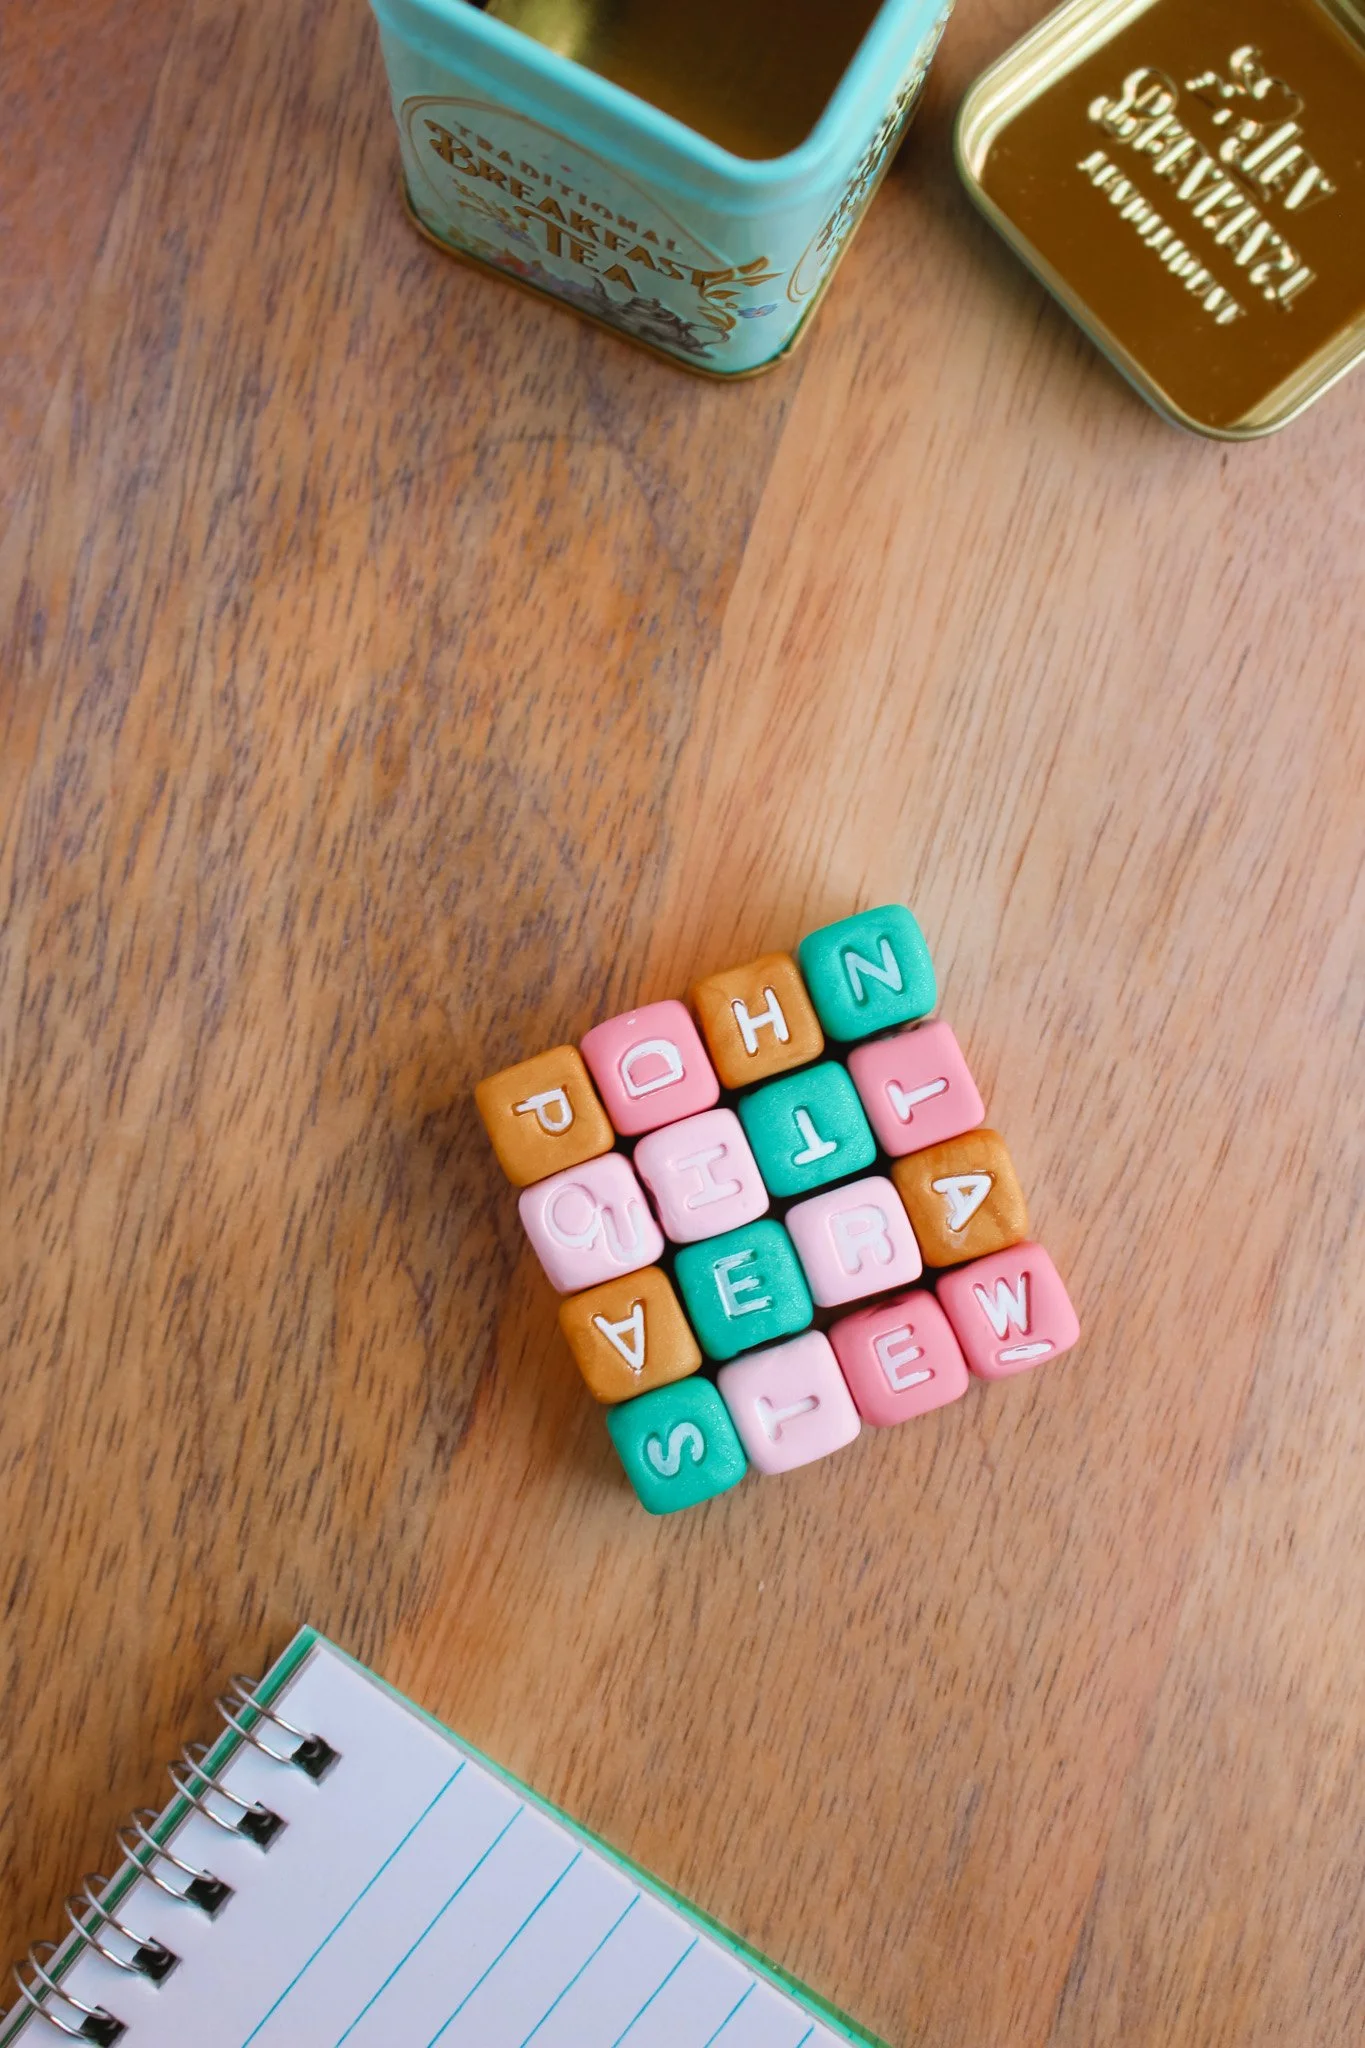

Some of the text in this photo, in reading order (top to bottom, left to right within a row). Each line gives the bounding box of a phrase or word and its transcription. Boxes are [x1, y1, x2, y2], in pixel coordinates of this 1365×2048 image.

[424, 119, 724, 289] BREAKFAST
[454, 121, 684, 255] TRADITIONAL
[514, 205, 638, 292] TEA
[512, 1087, 575, 1135] P
[620, 1039, 684, 1098] D
[732, 986, 790, 1056] H
[792, 1109, 838, 1166] T
[886, 1077, 949, 1124] T
[592, 1172, 994, 1372] A E R A
[646, 1422, 704, 1476] S
[757, 1395, 820, 1442] T
[874, 1324, 934, 1392] E
